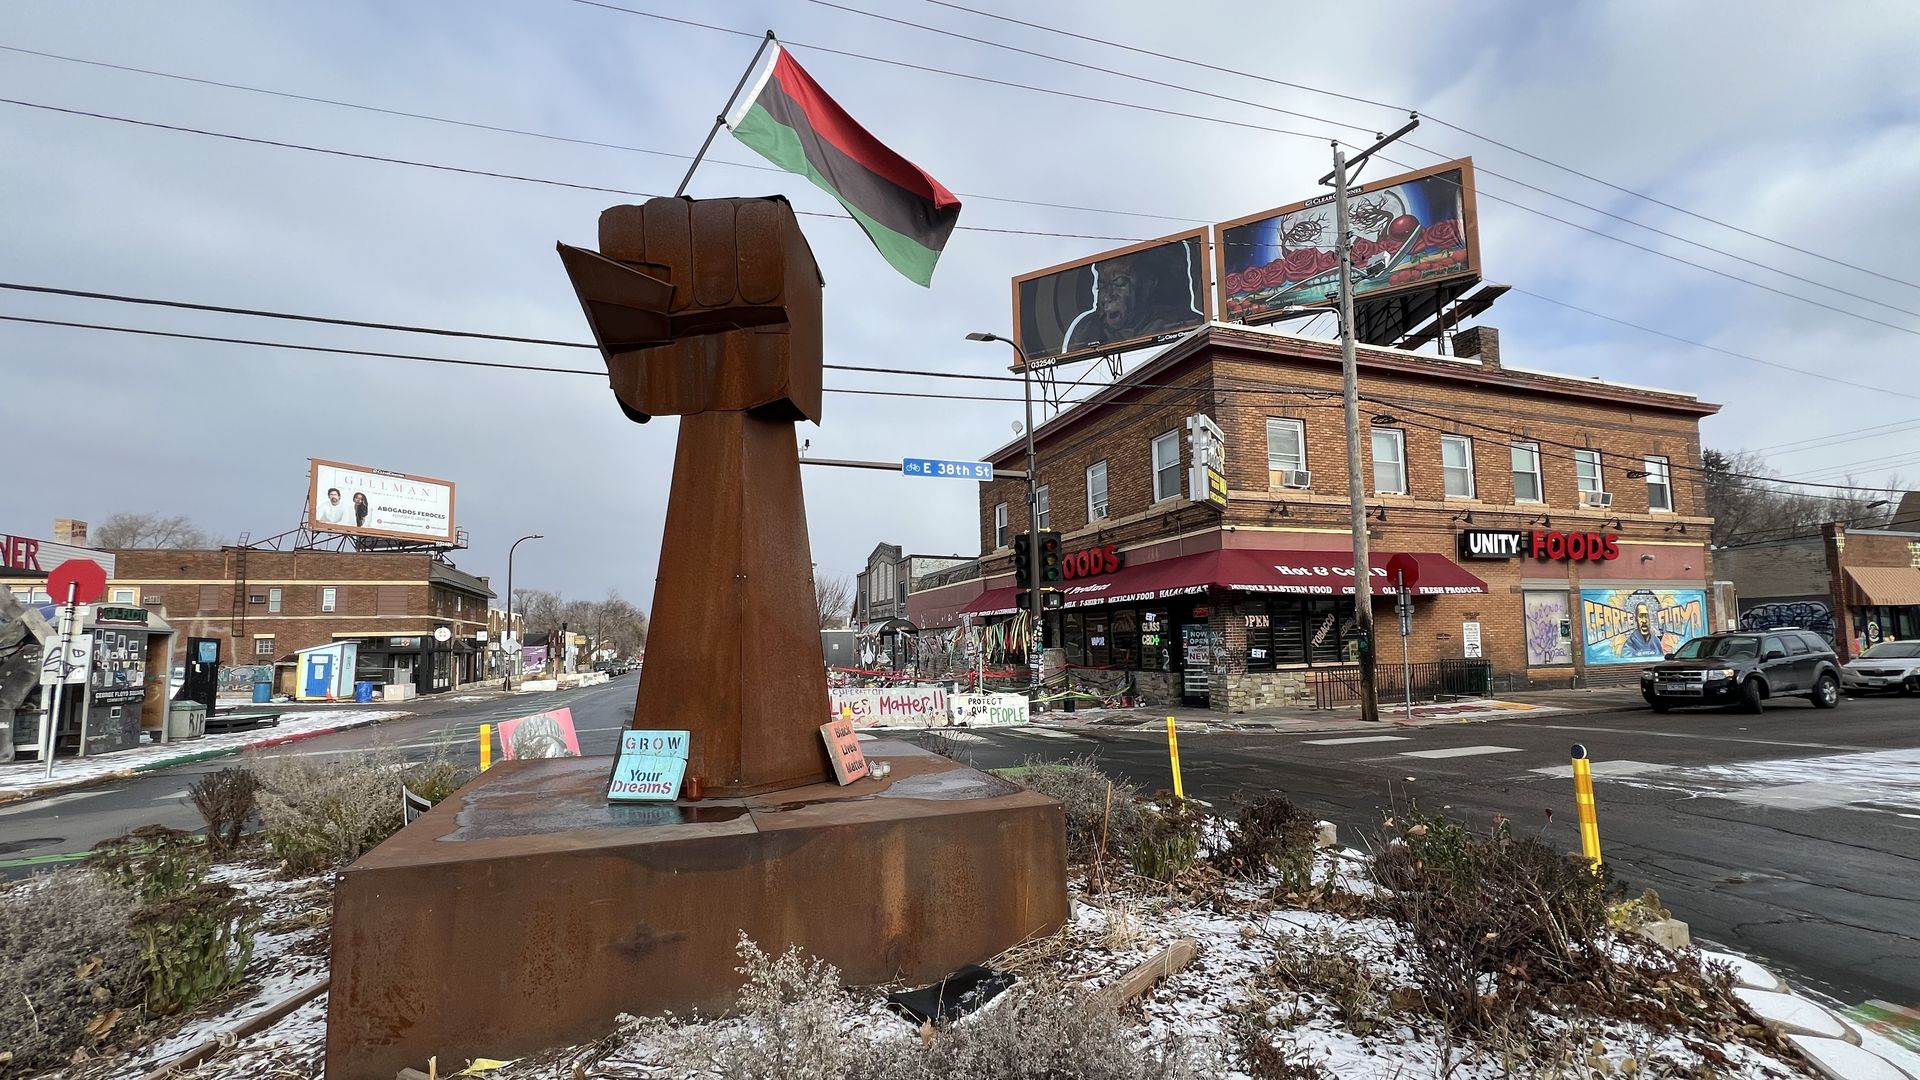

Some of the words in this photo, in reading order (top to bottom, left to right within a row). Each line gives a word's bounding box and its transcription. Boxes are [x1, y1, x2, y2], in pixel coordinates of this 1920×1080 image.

[1030, 357, 1056, 369] 032540
[923, 463, 931, 473] E
[938, 463, 969, 475] 38th
[975, 466, 989, 477] St
[344, 475, 432, 497] GILLMAN
[377, 505, 417, 516] ABOGADOS
[417, 511, 446, 520] FEROCES
[1469, 533, 1519, 553] UNITY
[1532, 531, 1620, 561] FOODS
[1062, 545, 1120, 580] OODS
[1274, 565, 1313, 576] Hot
[1265, 585, 1309, 594] EASTERN
[1308, 585, 1333, 594] FOOD
[1419, 586, 1445, 595] FRESH
[1444, 586, 1483, 594] PRODUCE
[1108, 593, 1137, 603] MEXICAN
[1135, 591, 1155, 601] FOOD
[1583, 598, 1638, 647] GEORGE
[1656, 600, 1704, 641] FLOYD
[1311, 613, 1336, 648] TOBACCO
[1189, 652, 1209, 661] NEW
[1251, 648, 1267, 659] EBT
[967, 697, 1003, 705] PROTECT
[989, 706, 1027, 724] PEOPLE
[188, 711, 206, 737] RIP
[834, 725, 852, 738] Black
[625, 737, 681, 750] GROW
[841, 744, 857, 755] Lives
[845, 759, 865, 773] Matter
[630, 769, 663, 782] Your
